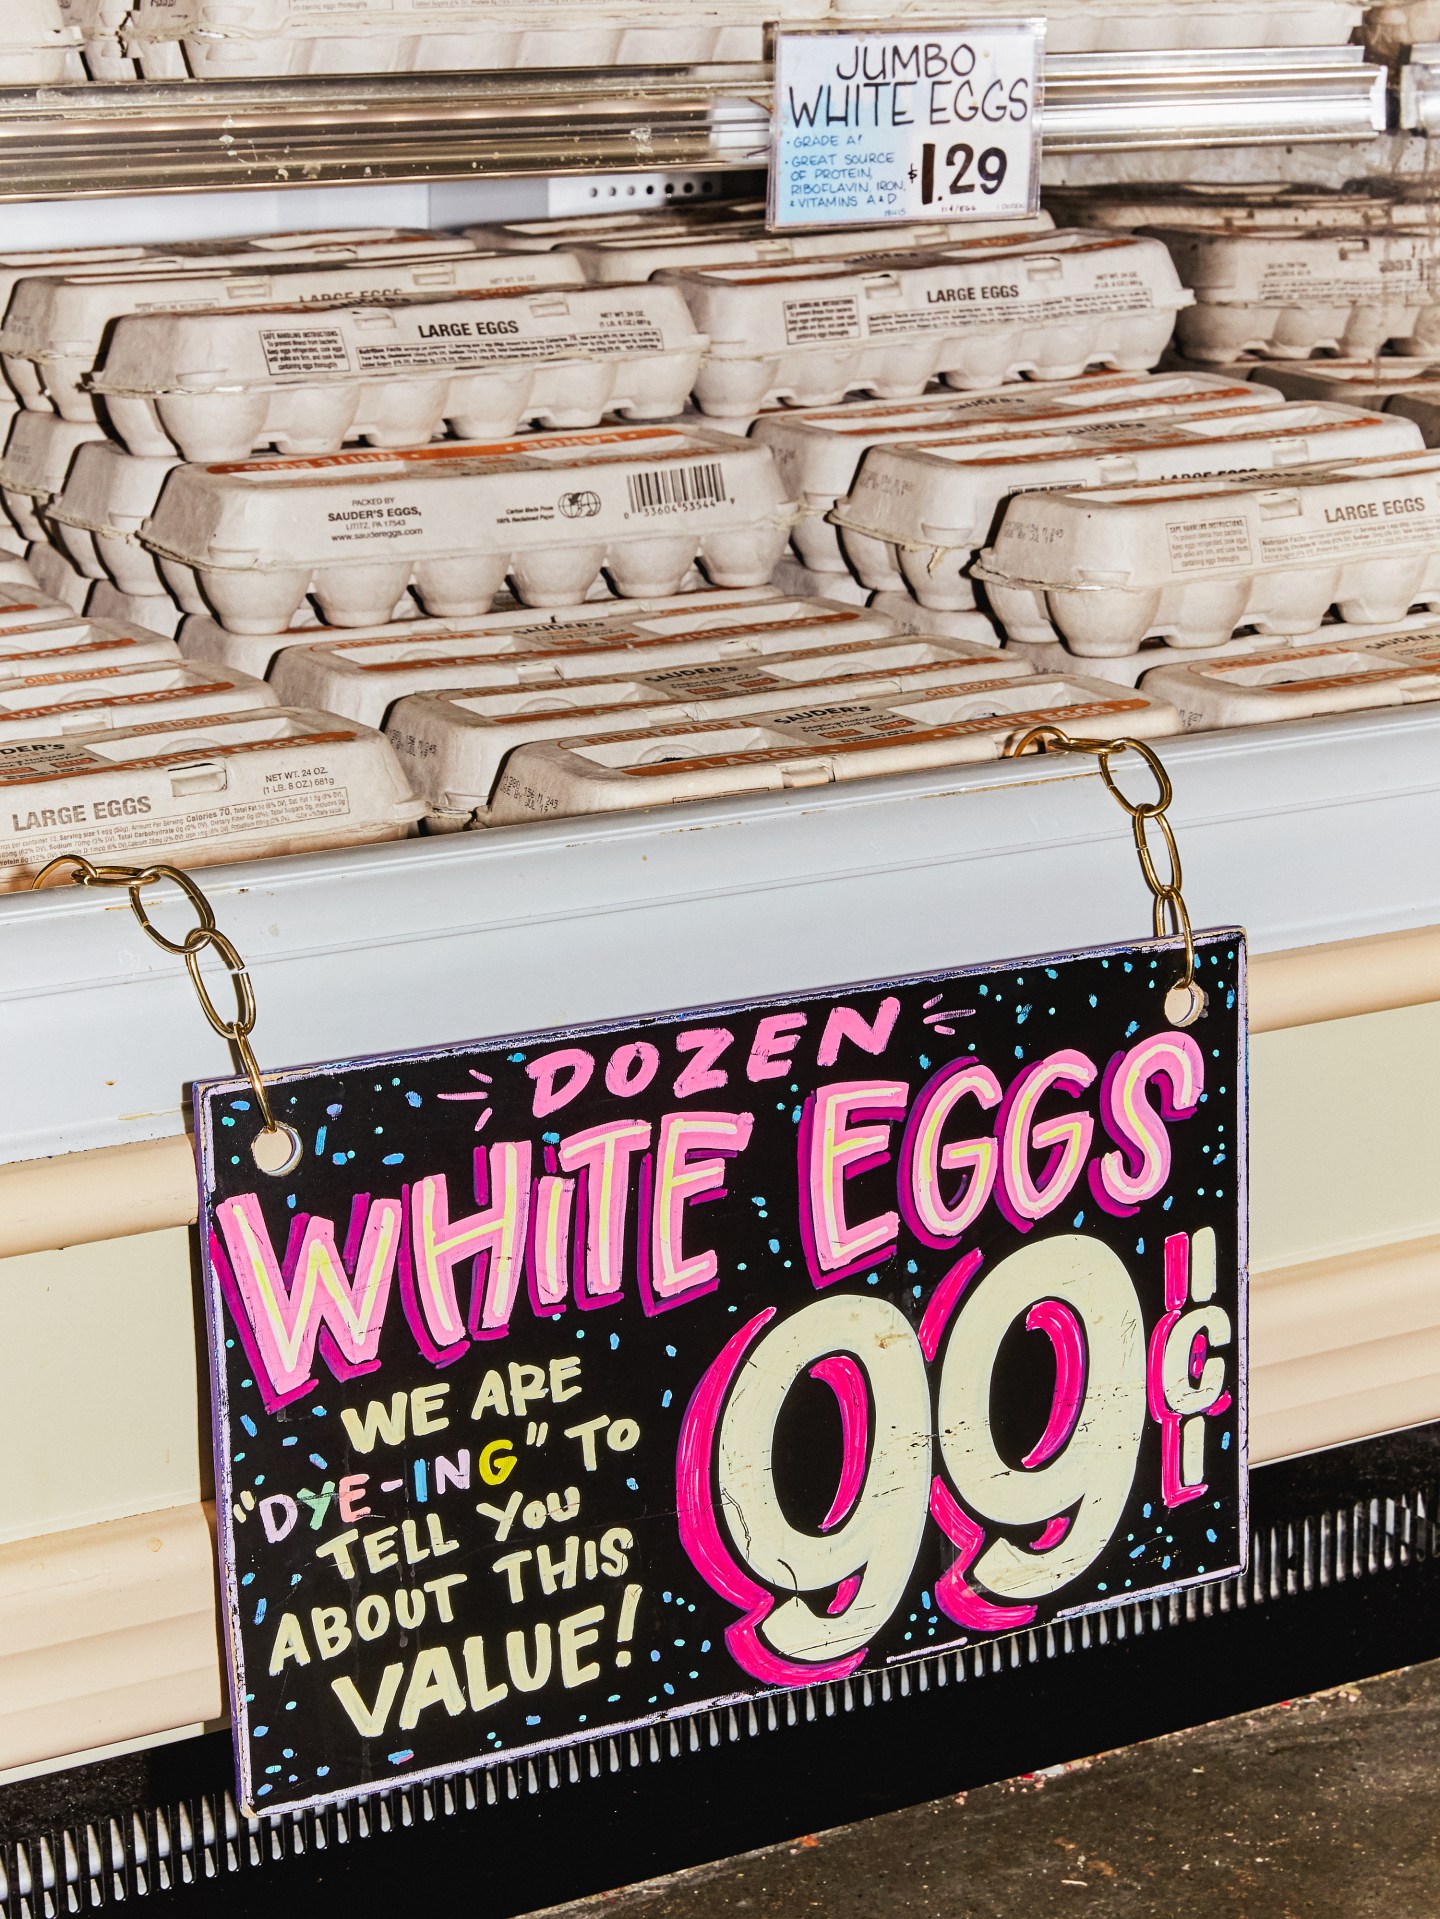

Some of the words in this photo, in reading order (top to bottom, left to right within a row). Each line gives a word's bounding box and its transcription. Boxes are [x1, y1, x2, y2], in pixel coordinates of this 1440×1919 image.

[837, 44, 976, 81] JUMBO
[789, 80, 918, 129] WHITE
[930, 78, 1028, 126] EGGS
[793, 136, 839, 148] GRADE
[791, 154, 837, 167] GREAT
[844, 152, 895, 165] SOURCE
[791, 170, 807, 181] OF
[798, 196, 858, 208] VITAMINS
[927, 286, 976, 303] LARGE
[981, 284, 1020, 299] EGGS
[418, 322, 472, 338] LARGE
[476, 320, 519, 336] EGGS
[352, 498, 382, 507] PACKED
[384, 497, 395, 505] BY
[1324, 503, 1379, 524] LARGE
[1382, 497, 1426, 516] EGGS
[327, 508, 384, 522] SAUDER'S
[388, 506, 422, 518] EGGS,
[331, 527, 423, 542] www.saudereggs.com
[372, 520, 382, 530] PA
[384, 519, 406, 528] 17543
[645, 666, 739, 683] SAUDER'S
[925, 685, 957, 698] ONE
[960, 678, 1012, 694] DOZEN
[132, 722, 166, 734] ONE
[170, 714, 231, 729] DOZEN
[774, 706, 872, 725] SAUDER'S
[584, 730, 654, 747] FRESH
[659, 723, 732, 740] GRADE
[738, 720, 759, 731] A
[699, 748, 818, 769] LARGE
[947, 715, 1036, 735] WHITE
[1043, 705, 1116, 722] EGGS
[265, 773, 282, 783] NET
[284, 771, 300, 780] WT.
[302, 769, 311, 777] 24
[313, 766, 328, 776] OZ.
[263, 786, 270, 795] (1
[273, 783, 286, 793] LB.
[288, 782, 293, 790] 8
[314, 777, 335, 787] 681g
[12, 804, 87, 832] LARGE
[93, 796, 151, 820] EGGS
[60, 832, 82, 841] Serving
[83, 830, 95, 838] size
[101, 828, 112, 836] egg
[131, 823, 152, 831] Amount
[186, 811, 217, 822] Calories
[234, 805, 247, 813] Total
[248, 804, 257, 812] Fat
[49, 843, 72, 851] Sodium
[117, 833, 133, 841] Total
[134, 827, 174, 838] Carbohydrate
[526, 997, 900, 1118] DOZEN
[211, 1112, 754, 1411] WHITE
[798, 1031, 1204, 1287] EGGS
[341, 1383, 450, 1454] WE
[470, 1356, 582, 1421] ARE
[564, 1415, 641, 1472] TO
[316, 1513, 460, 1580] TELL
[269, 1574, 468, 1676] ABOUT
[493, 1527, 634, 1604] THIS
[331, 1584, 643, 1738] VALUE!
